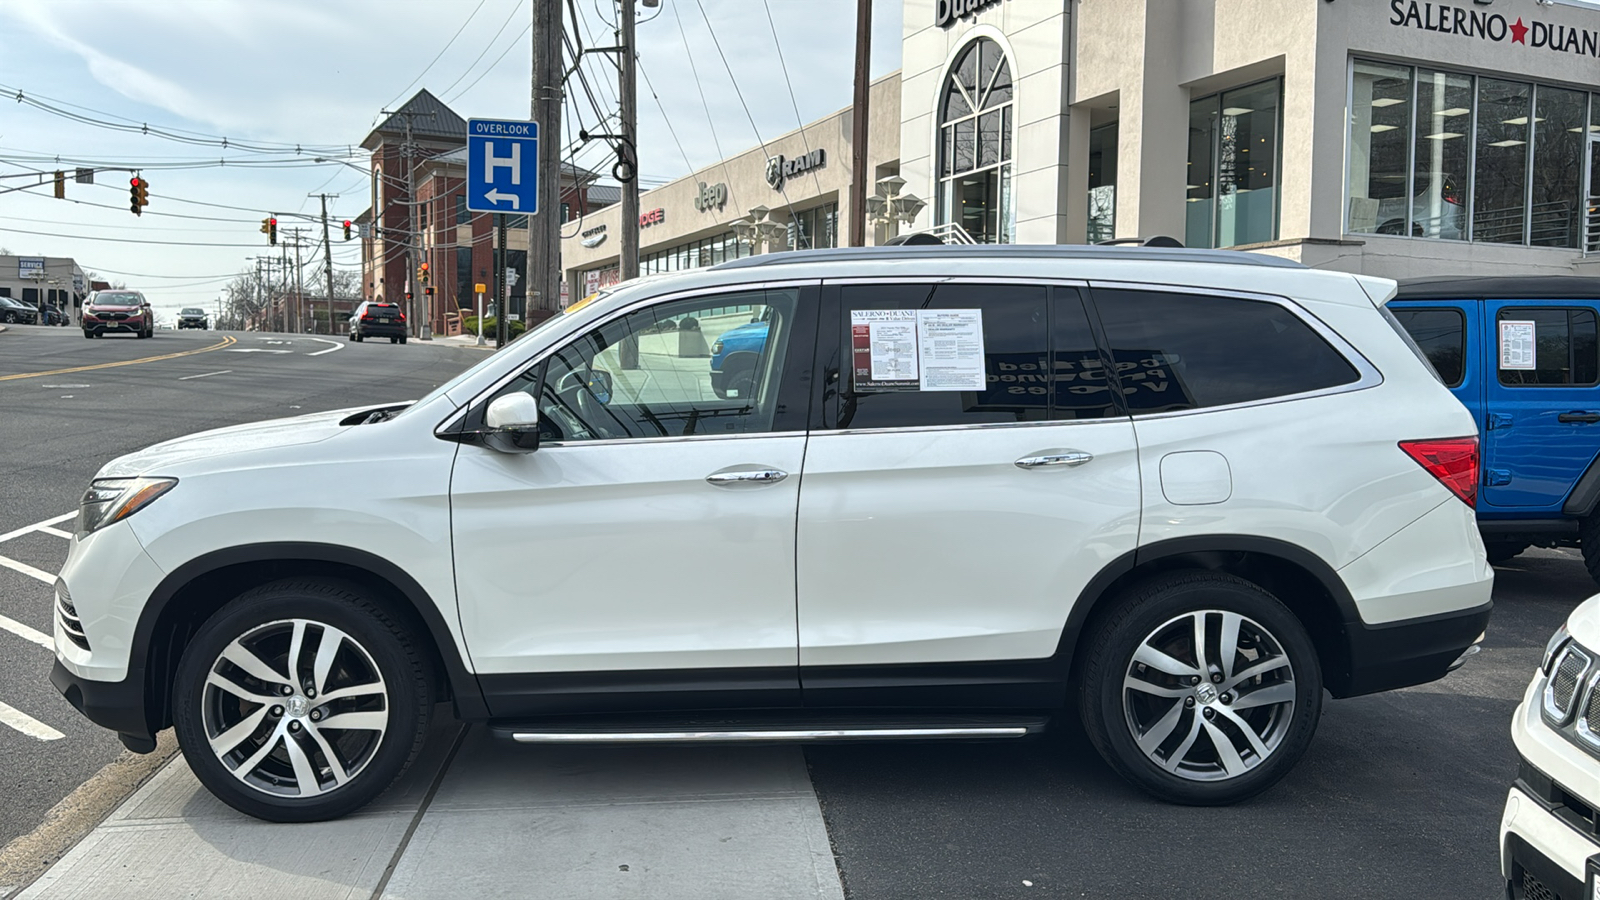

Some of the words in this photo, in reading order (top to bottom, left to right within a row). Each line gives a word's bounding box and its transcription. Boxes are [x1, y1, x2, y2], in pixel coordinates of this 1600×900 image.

[936, 0, 994, 27] Dua
[1390, 0, 1508, 42] SALERNO
[1530, 20, 1600, 58] DUAN
[476, 123, 530, 135] OVERLOOK
[484, 141, 521, 185] H
[782, 148, 826, 178] RAM
[694, 181, 725, 211] Jeep
[639, 207, 664, 226] DGE
[20, 261, 43, 269] SERVICE
